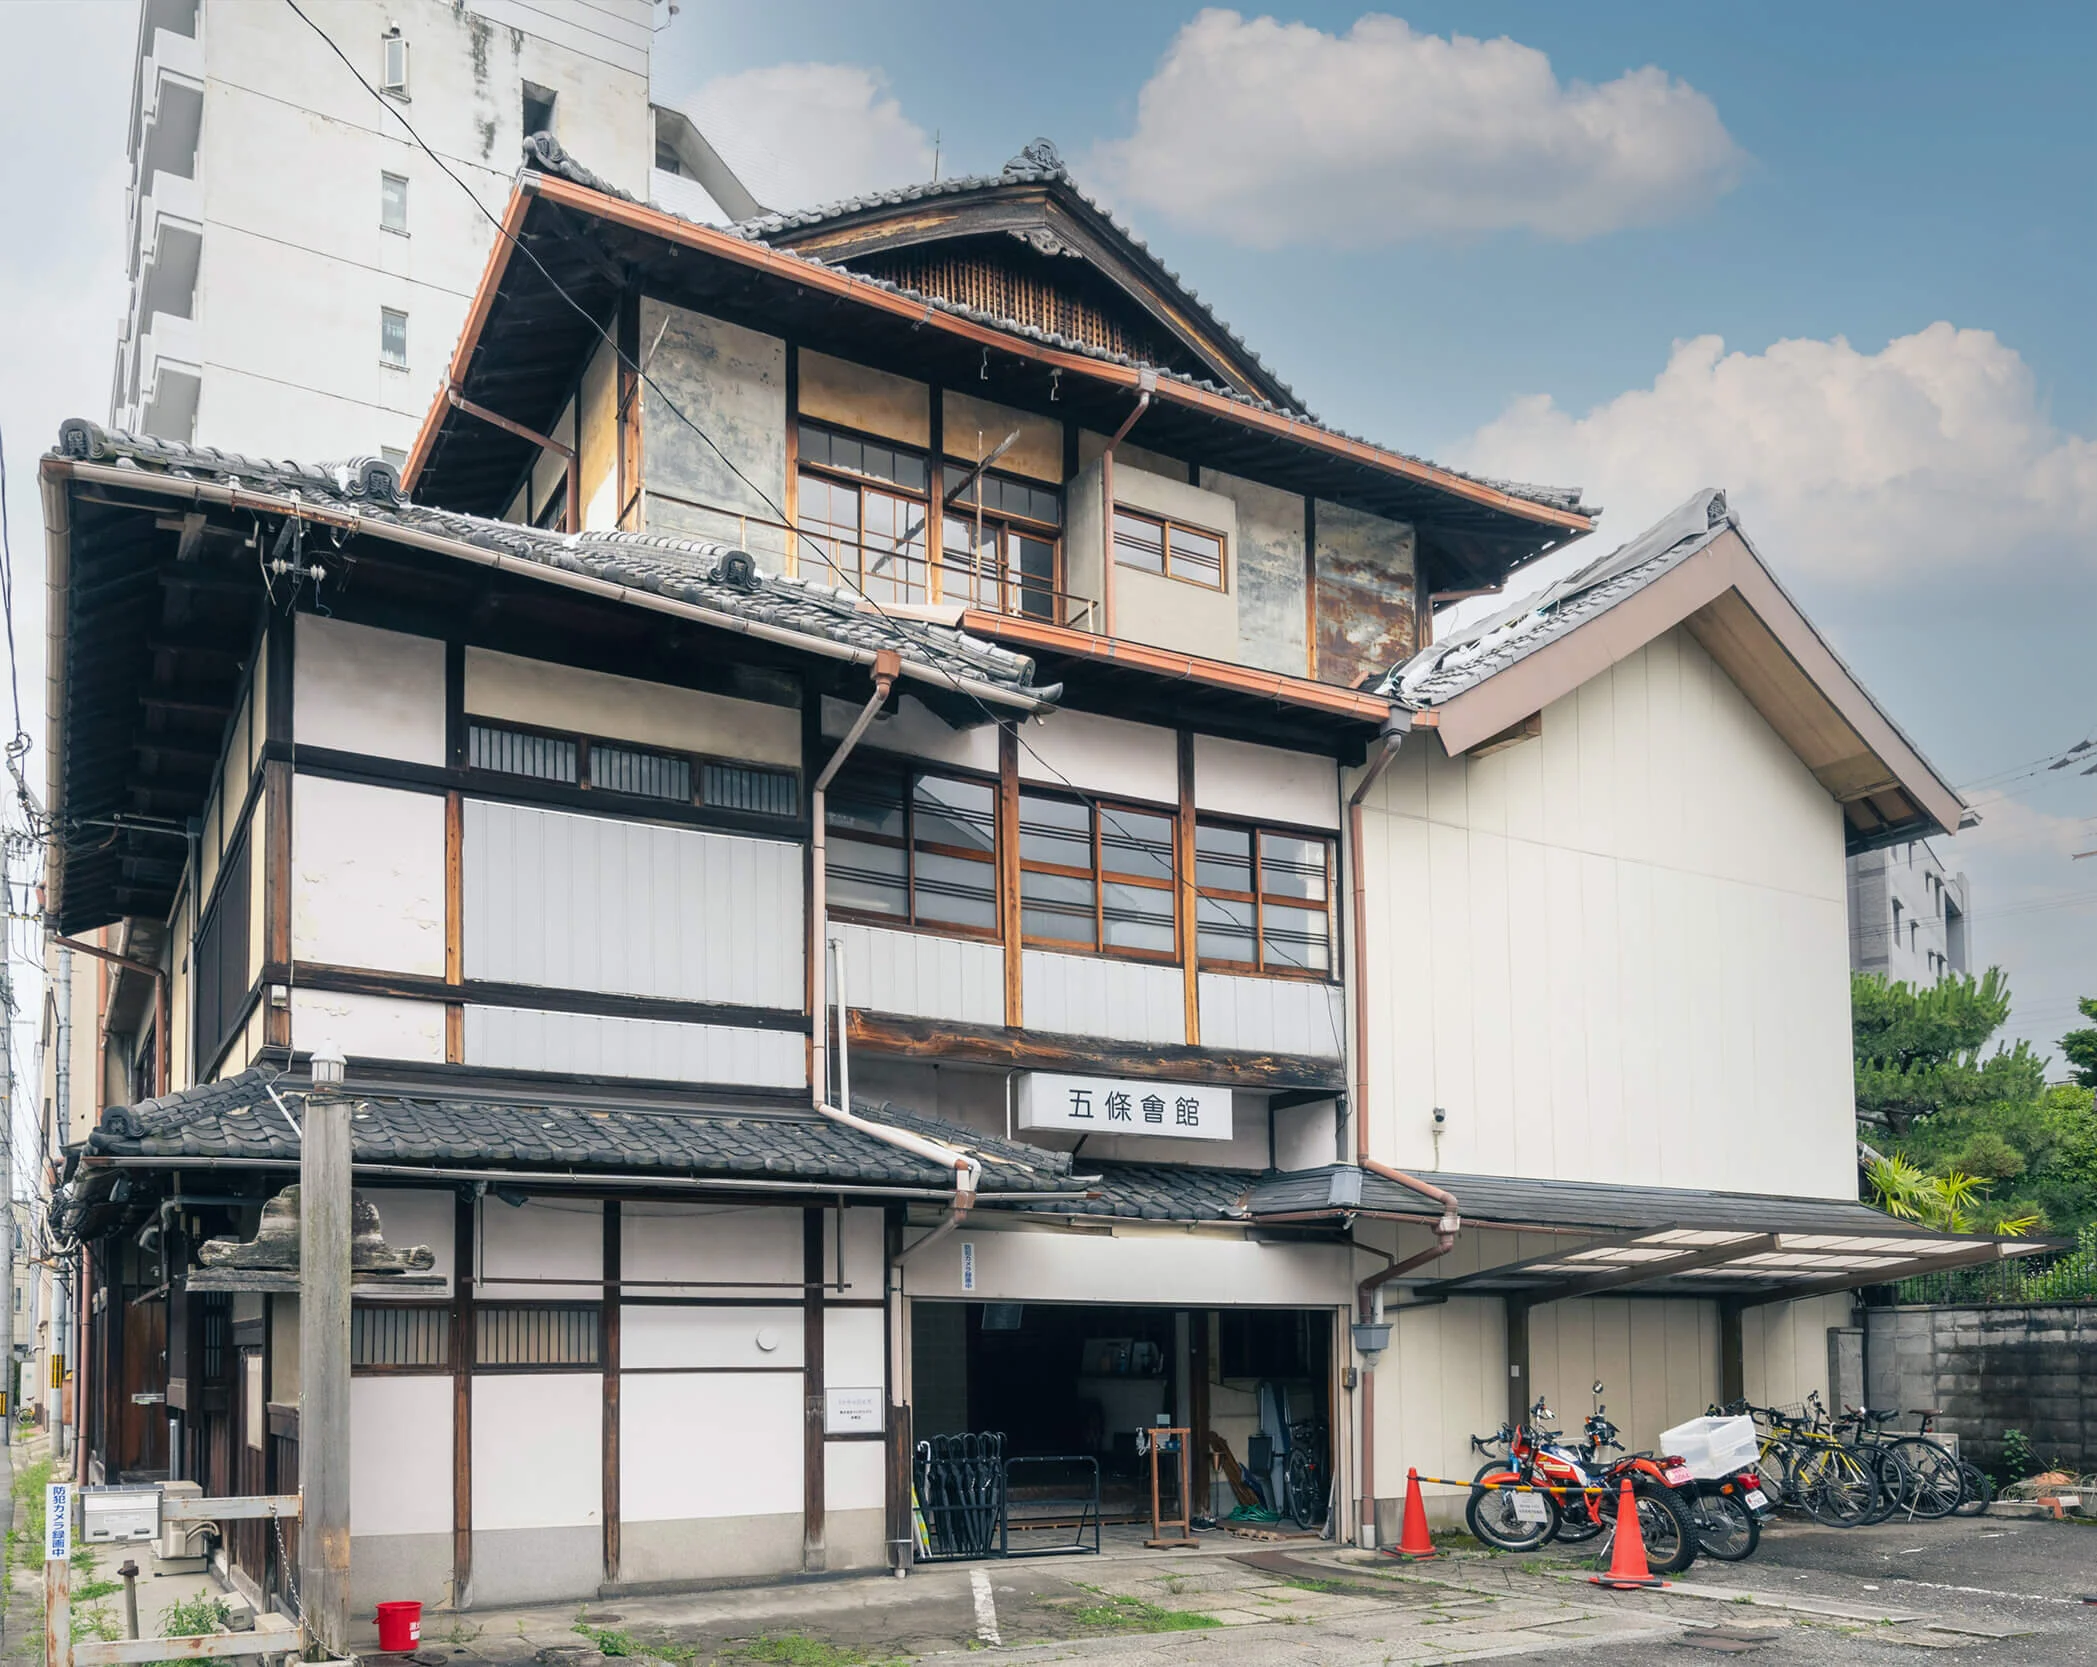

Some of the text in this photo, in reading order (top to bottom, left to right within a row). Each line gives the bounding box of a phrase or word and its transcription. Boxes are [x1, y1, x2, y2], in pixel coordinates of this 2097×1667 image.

[1067, 1089, 1200, 1127] 五條會館
[52, 1486, 66, 1557] 防犯カメラ録画中
